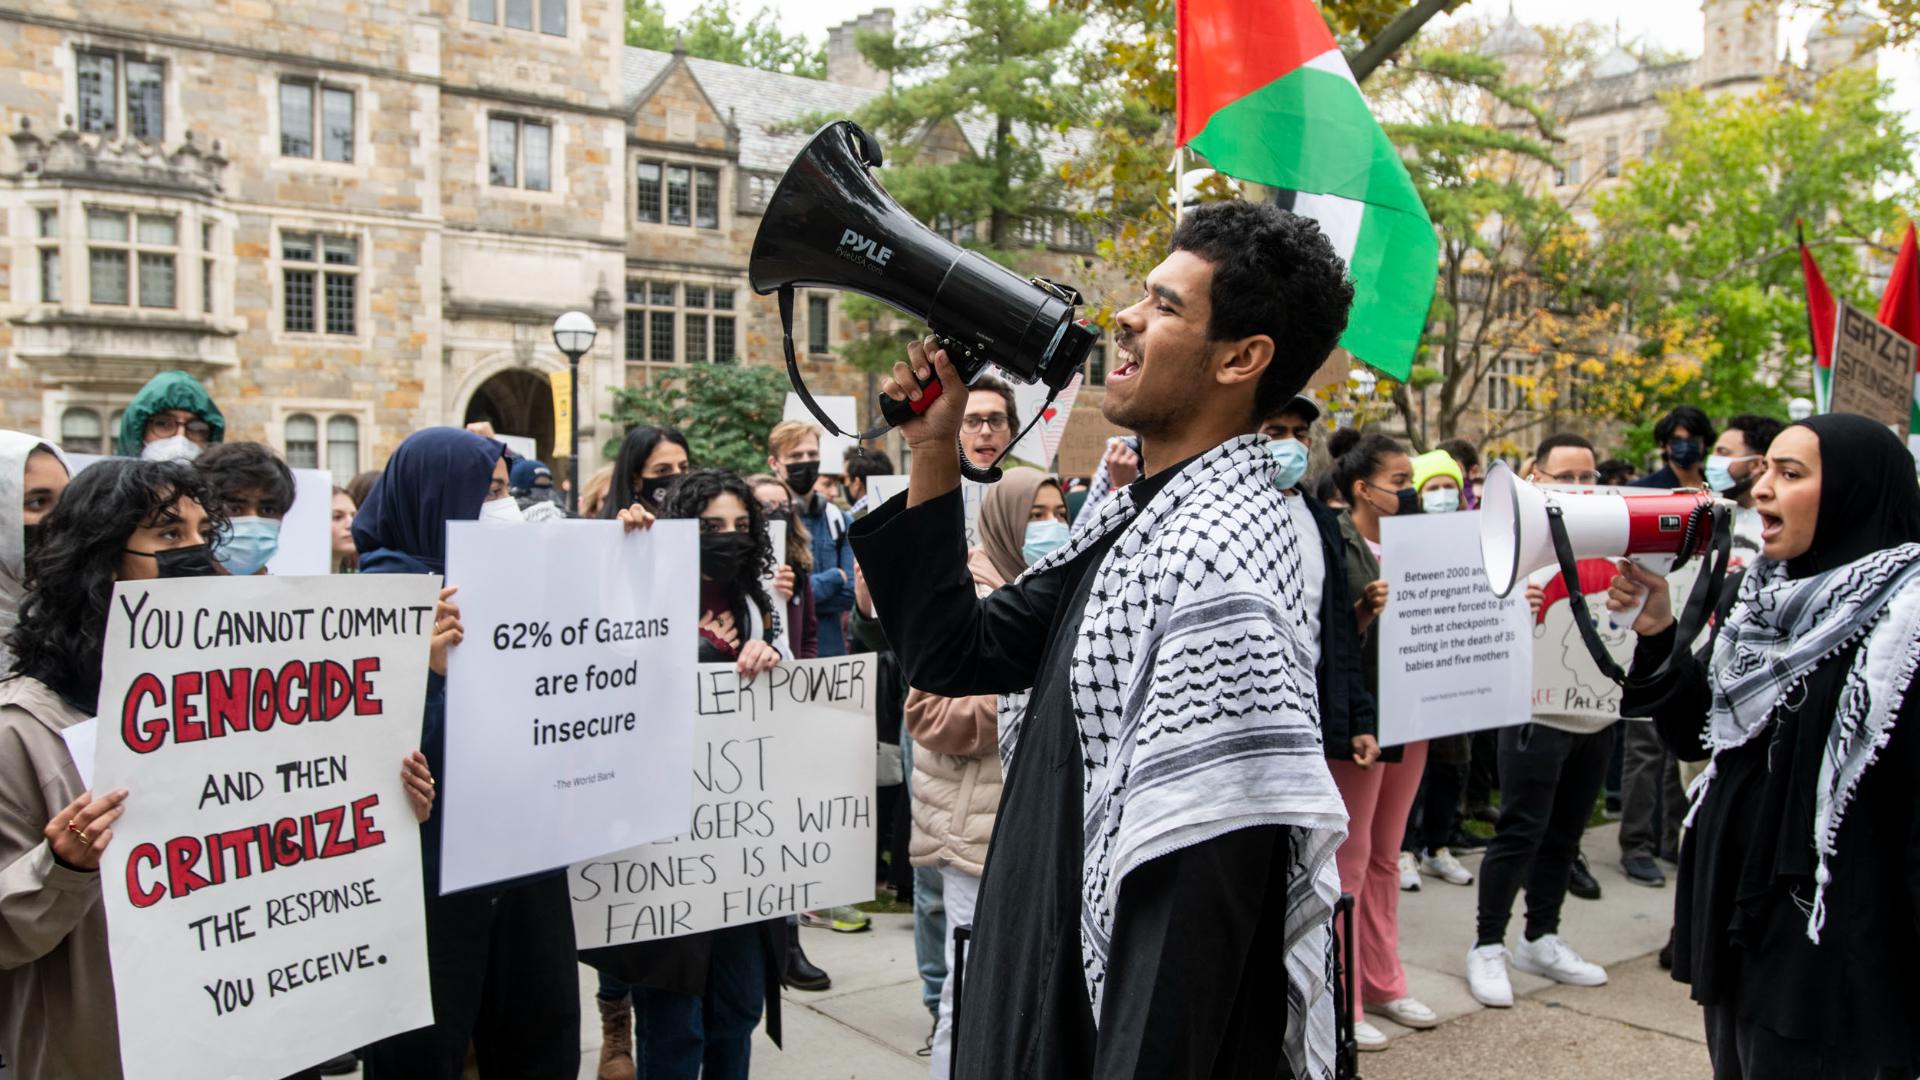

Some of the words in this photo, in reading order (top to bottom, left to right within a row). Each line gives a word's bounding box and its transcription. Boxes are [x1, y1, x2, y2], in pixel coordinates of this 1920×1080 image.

[840, 228, 893, 266] PYLE
[1844, 305, 1910, 374] GAZA
[1396, 590, 1417, 601] 10%
[1418, 587, 1429, 599] of
[1430, 585, 1471, 600] pregnant
[1404, 571, 1445, 582] Between
[1446, 567, 1470, 579] 2000
[120, 591, 184, 649] YOU
[193, 607, 315, 649] CANNOT
[321, 605, 433, 641] COMMIT
[1398, 607, 1432, 618] women
[1434, 604, 1456, 615] were
[1458, 600, 1486, 612] forced
[1488, 600, 1498, 609] to
[1499, 599, 1516, 610] give
[1411, 624, 1433, 635] birth
[1435, 623, 1445, 633] at
[1446, 617, 1500, 631] checkpoints
[493, 621, 552, 651] 62%
[561, 617, 590, 646] of
[595, 616, 669, 644] Gazans
[1399, 641, 1439, 655] resulting
[1440, 639, 1449, 649] in
[1450, 638, 1465, 648] the
[1467, 634, 1493, 646] death
[1494, 632, 1504, 642] of
[535, 673, 578, 697] are
[585, 659, 638, 692] food
[1405, 660, 1434, 672] babies
[1435, 656, 1453, 668] and
[1454, 654, 1472, 664] five
[1473, 650, 1509, 662] mothers
[768, 660, 866, 711] POWER
[1565, 687, 1617, 713] PALES
[121, 656, 383, 754] GENOCIDE
[534, 711, 636, 746] insecure
[198, 771, 264, 810] AND
[275, 754, 348, 794] THEN
[573, 773, 596, 787] World
[597, 770, 616, 782] Bank
[797, 795, 871, 833] WITH
[125, 793, 386, 908] CRITICIZE
[572, 854, 717, 902] STONES
[743, 846, 765, 878] IS
[781, 841, 832, 872] NO
[188, 905, 256, 951] THE
[266, 878, 381, 930] RESPONSE
[605, 900, 693, 944] FAIR
[204, 977, 254, 1016] YOU
[268, 944, 388, 998] RECEIVE.
